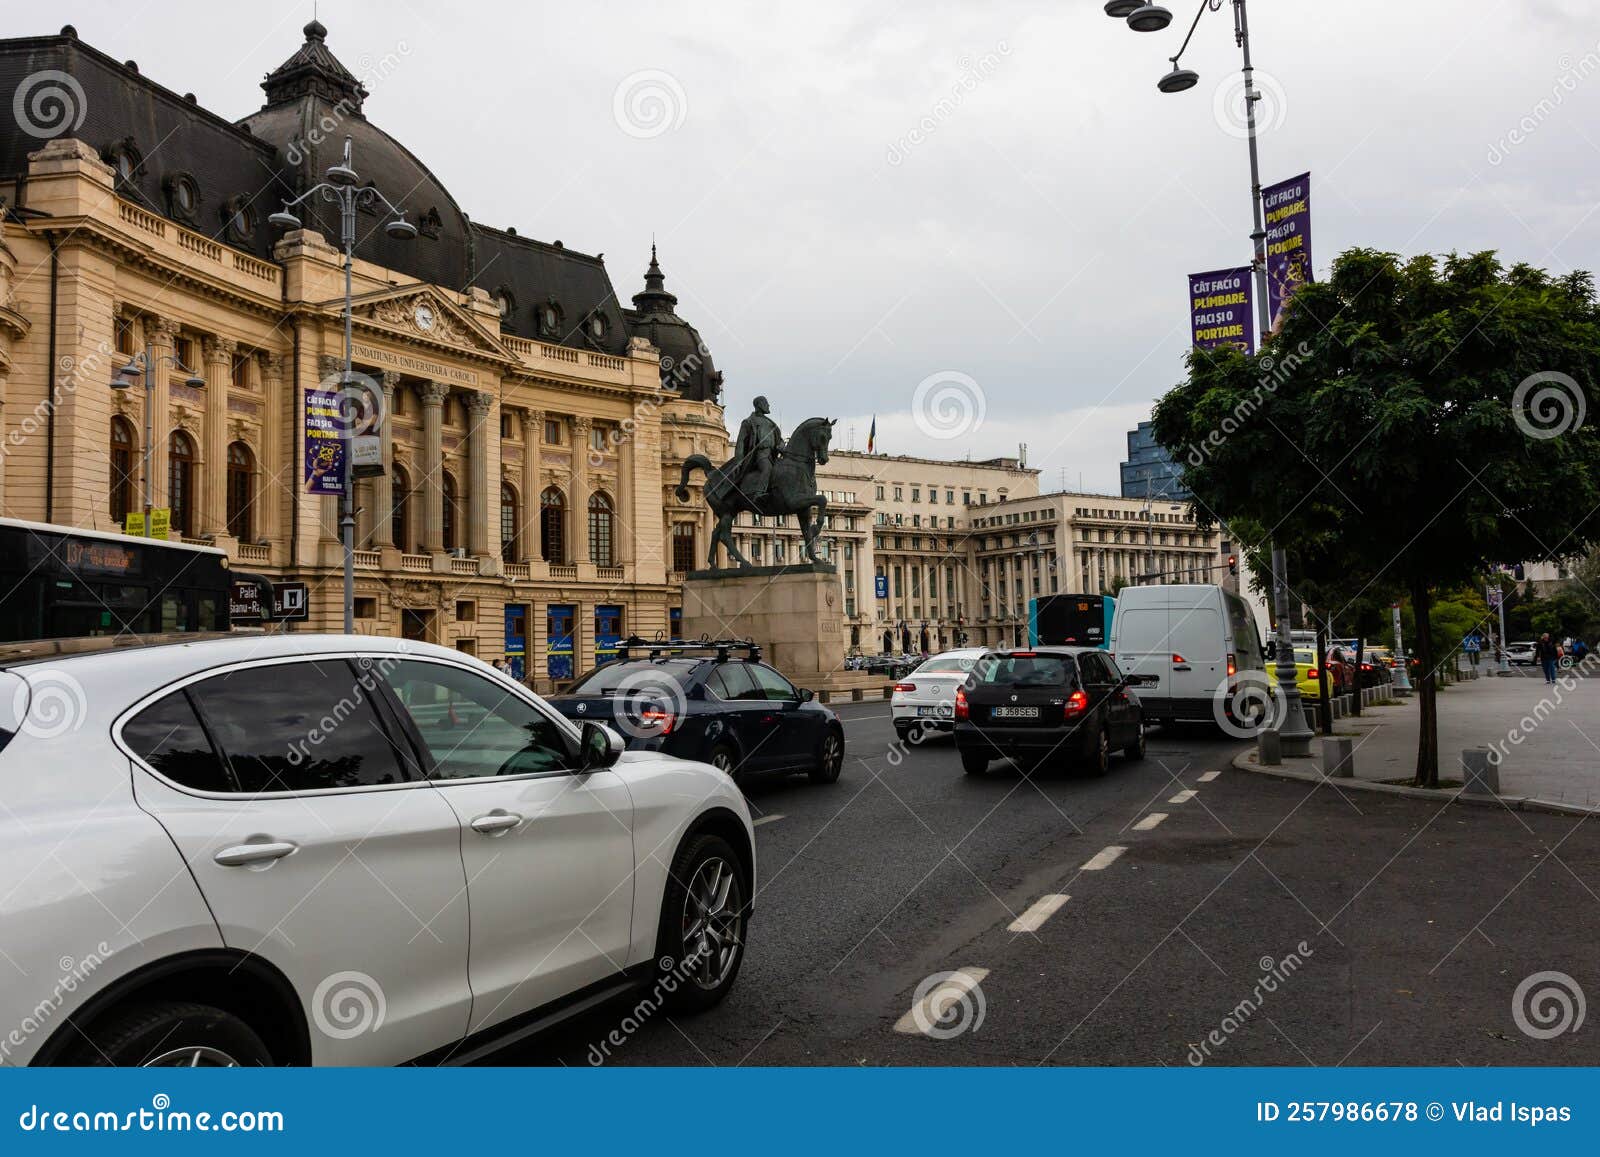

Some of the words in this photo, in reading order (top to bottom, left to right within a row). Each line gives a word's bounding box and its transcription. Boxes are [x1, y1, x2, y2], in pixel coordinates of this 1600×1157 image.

[1279, 188, 1294, 201] FACI
[1296, 186, 1301, 197] O
[1268, 234, 1303, 256] PORTARE
[1193, 281, 1210, 294] CÂT
[1211, 279, 1232, 292] FACI
[1233, 278, 1240, 288] O
[1195, 313, 1215, 326] FACI
[1226, 310, 1233, 321] O
[1196, 324, 1243, 342] PORTARE
[239, 586, 258, 599] Palat
